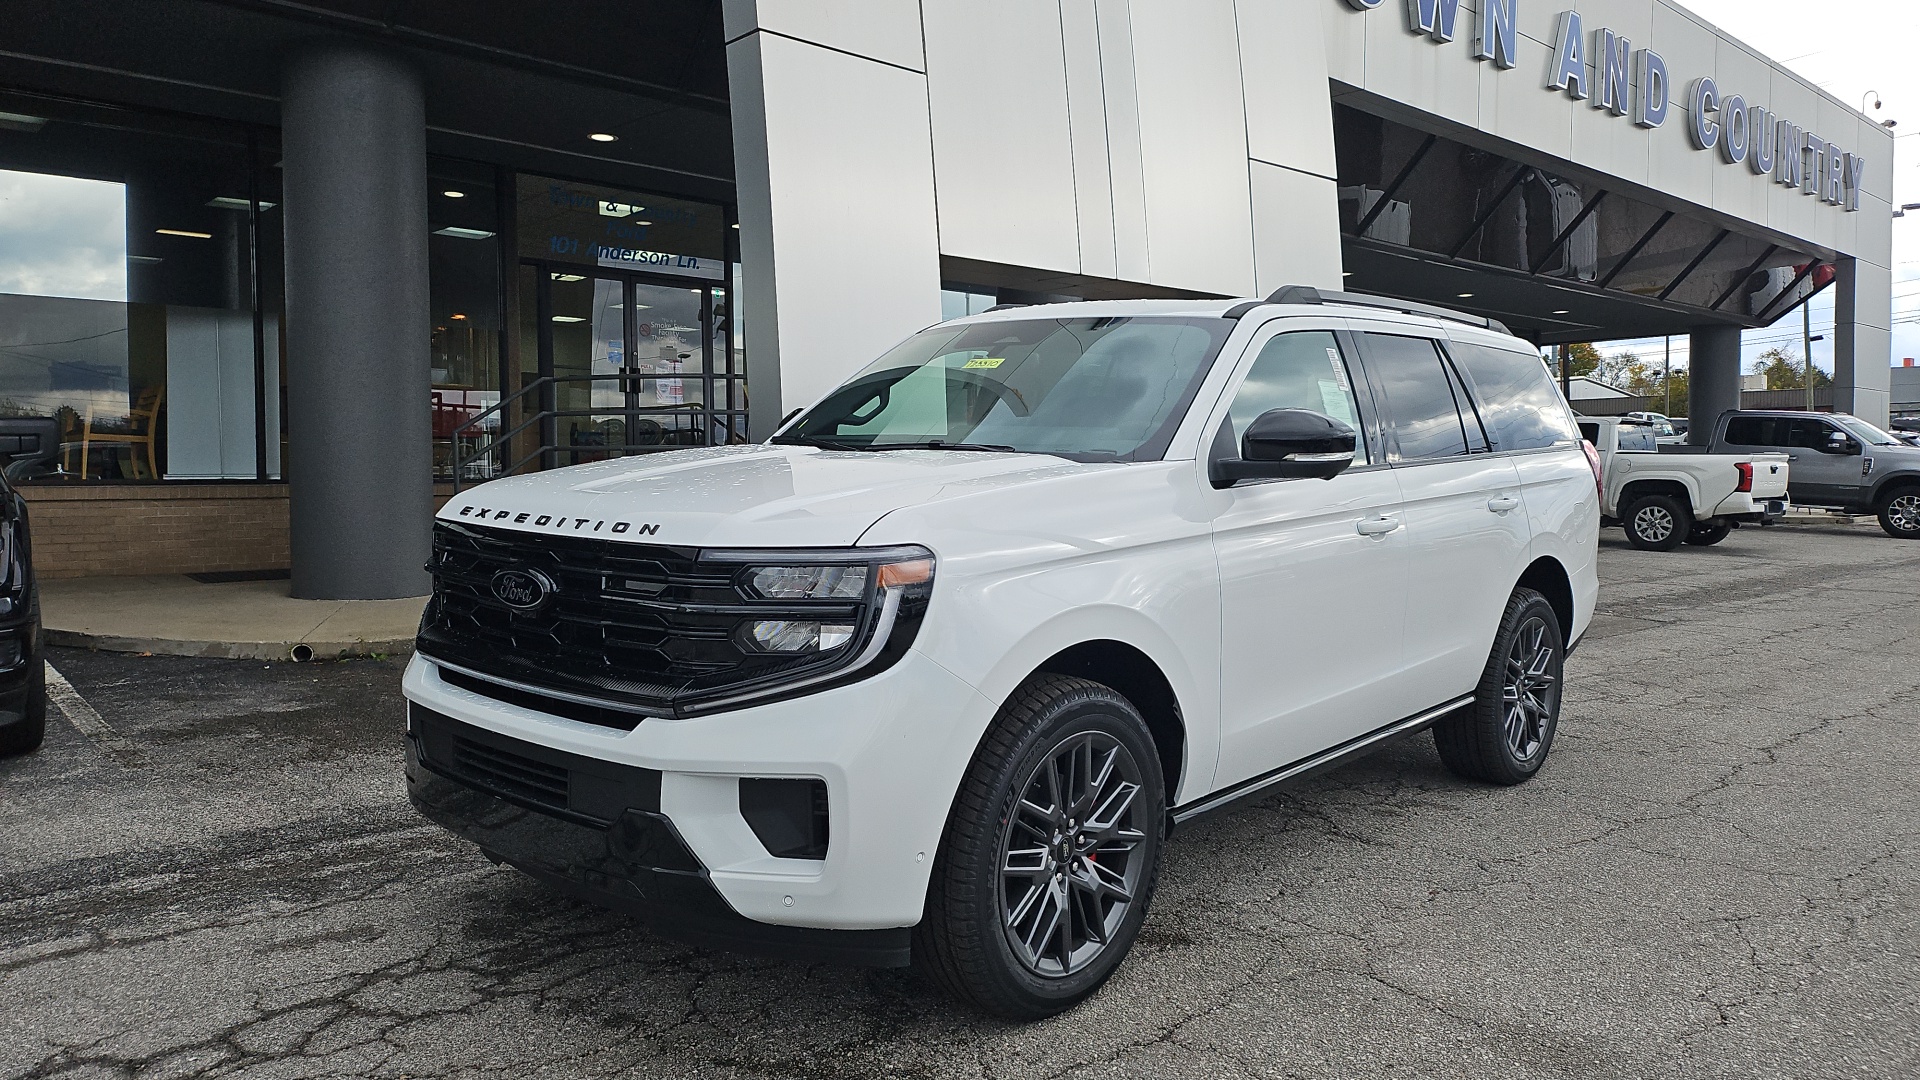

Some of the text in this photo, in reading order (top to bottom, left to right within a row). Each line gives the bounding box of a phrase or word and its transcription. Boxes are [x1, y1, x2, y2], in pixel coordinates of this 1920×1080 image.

[1548, 10, 1670, 129] AND
[1688, 77, 1865, 212] COUNTRY
[606, 197, 618, 213] &
[550, 236, 701, 270] 101 Anderson Ln.
[459, 505, 661, 536] EXPEDITION
[500, 574, 534, 604] Ford
